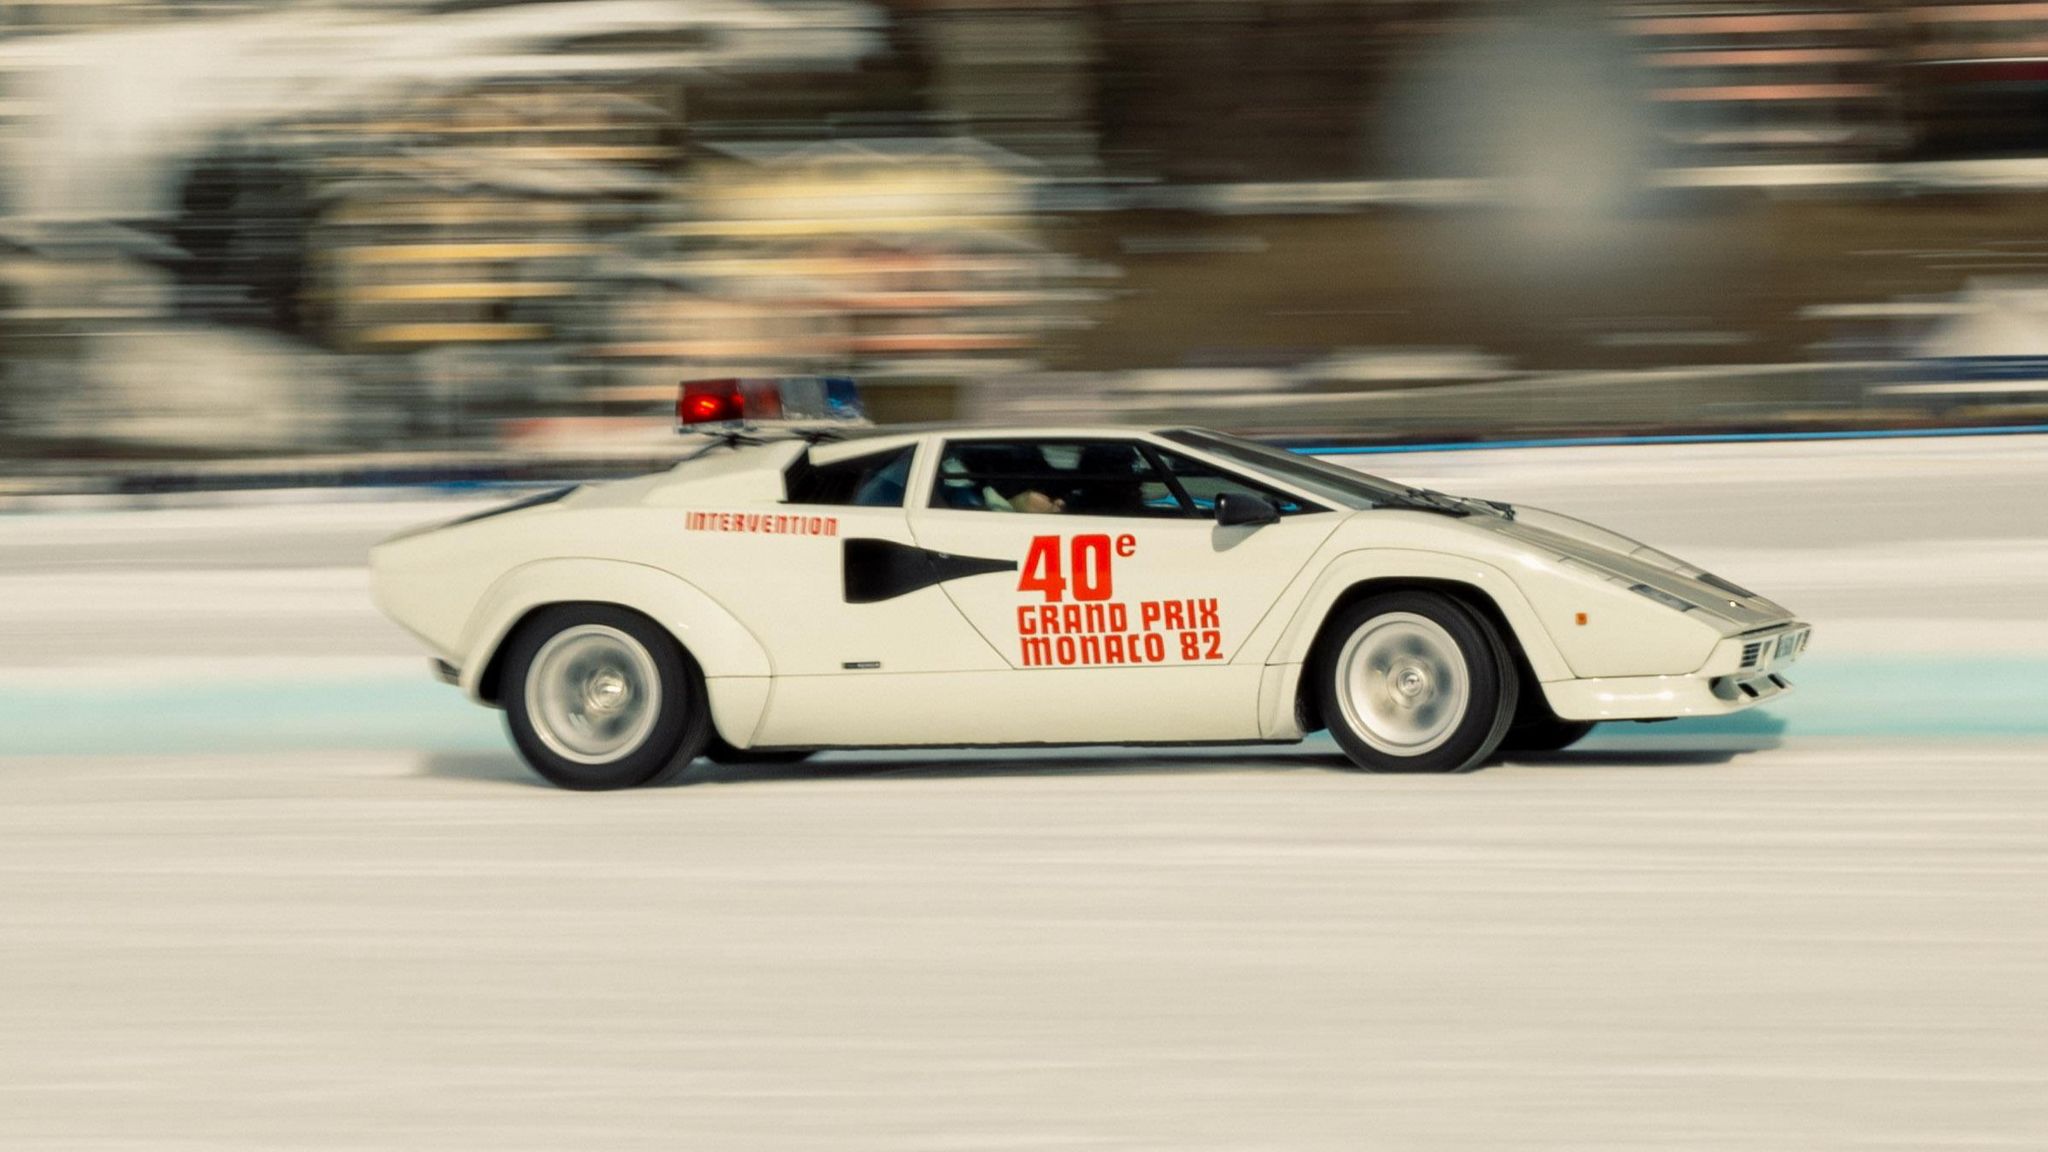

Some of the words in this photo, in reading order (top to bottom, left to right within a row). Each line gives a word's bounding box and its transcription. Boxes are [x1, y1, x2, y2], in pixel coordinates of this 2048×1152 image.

[686, 511, 839, 536] INTERVENTION
[1016, 533, 1137, 603] 40e
[1016, 603, 1128, 635] GRAND
[1140, 598, 1221, 630] PRIX
[1020, 632, 1166, 666] MONACO
[1179, 630, 1224, 662] 82
